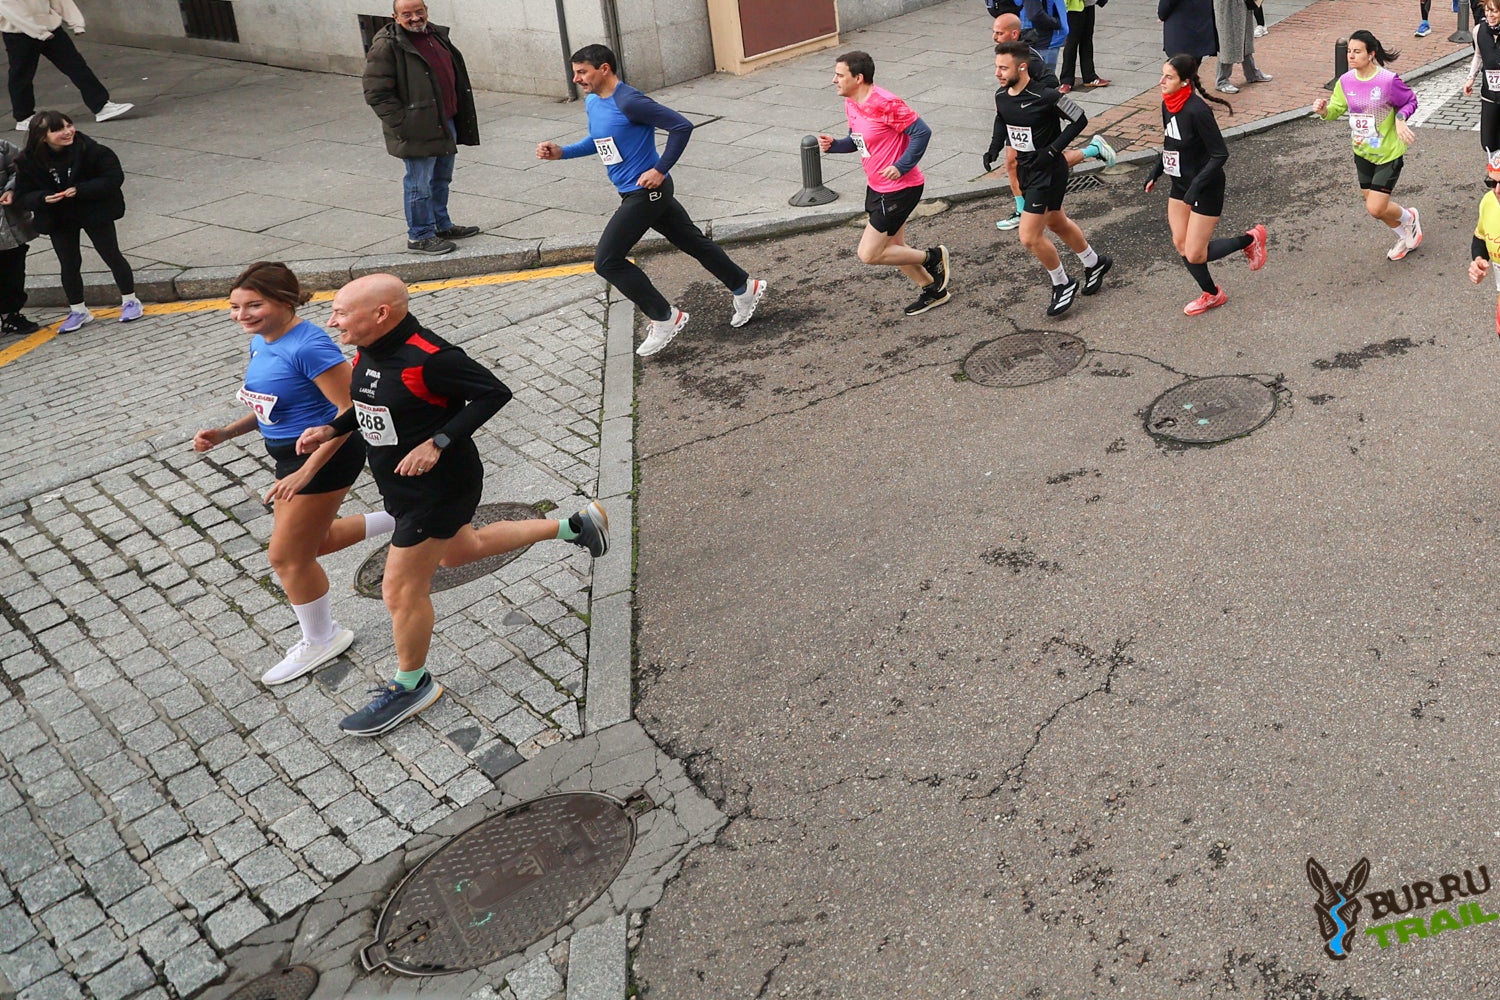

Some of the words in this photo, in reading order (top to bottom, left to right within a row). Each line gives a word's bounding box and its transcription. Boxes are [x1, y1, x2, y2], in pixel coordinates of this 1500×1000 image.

[1355, 119, 1368, 129] 82
[1010, 132, 1029, 143] 442
[598, 144, 613, 156] 351
[358, 411, 386, 431] 268
